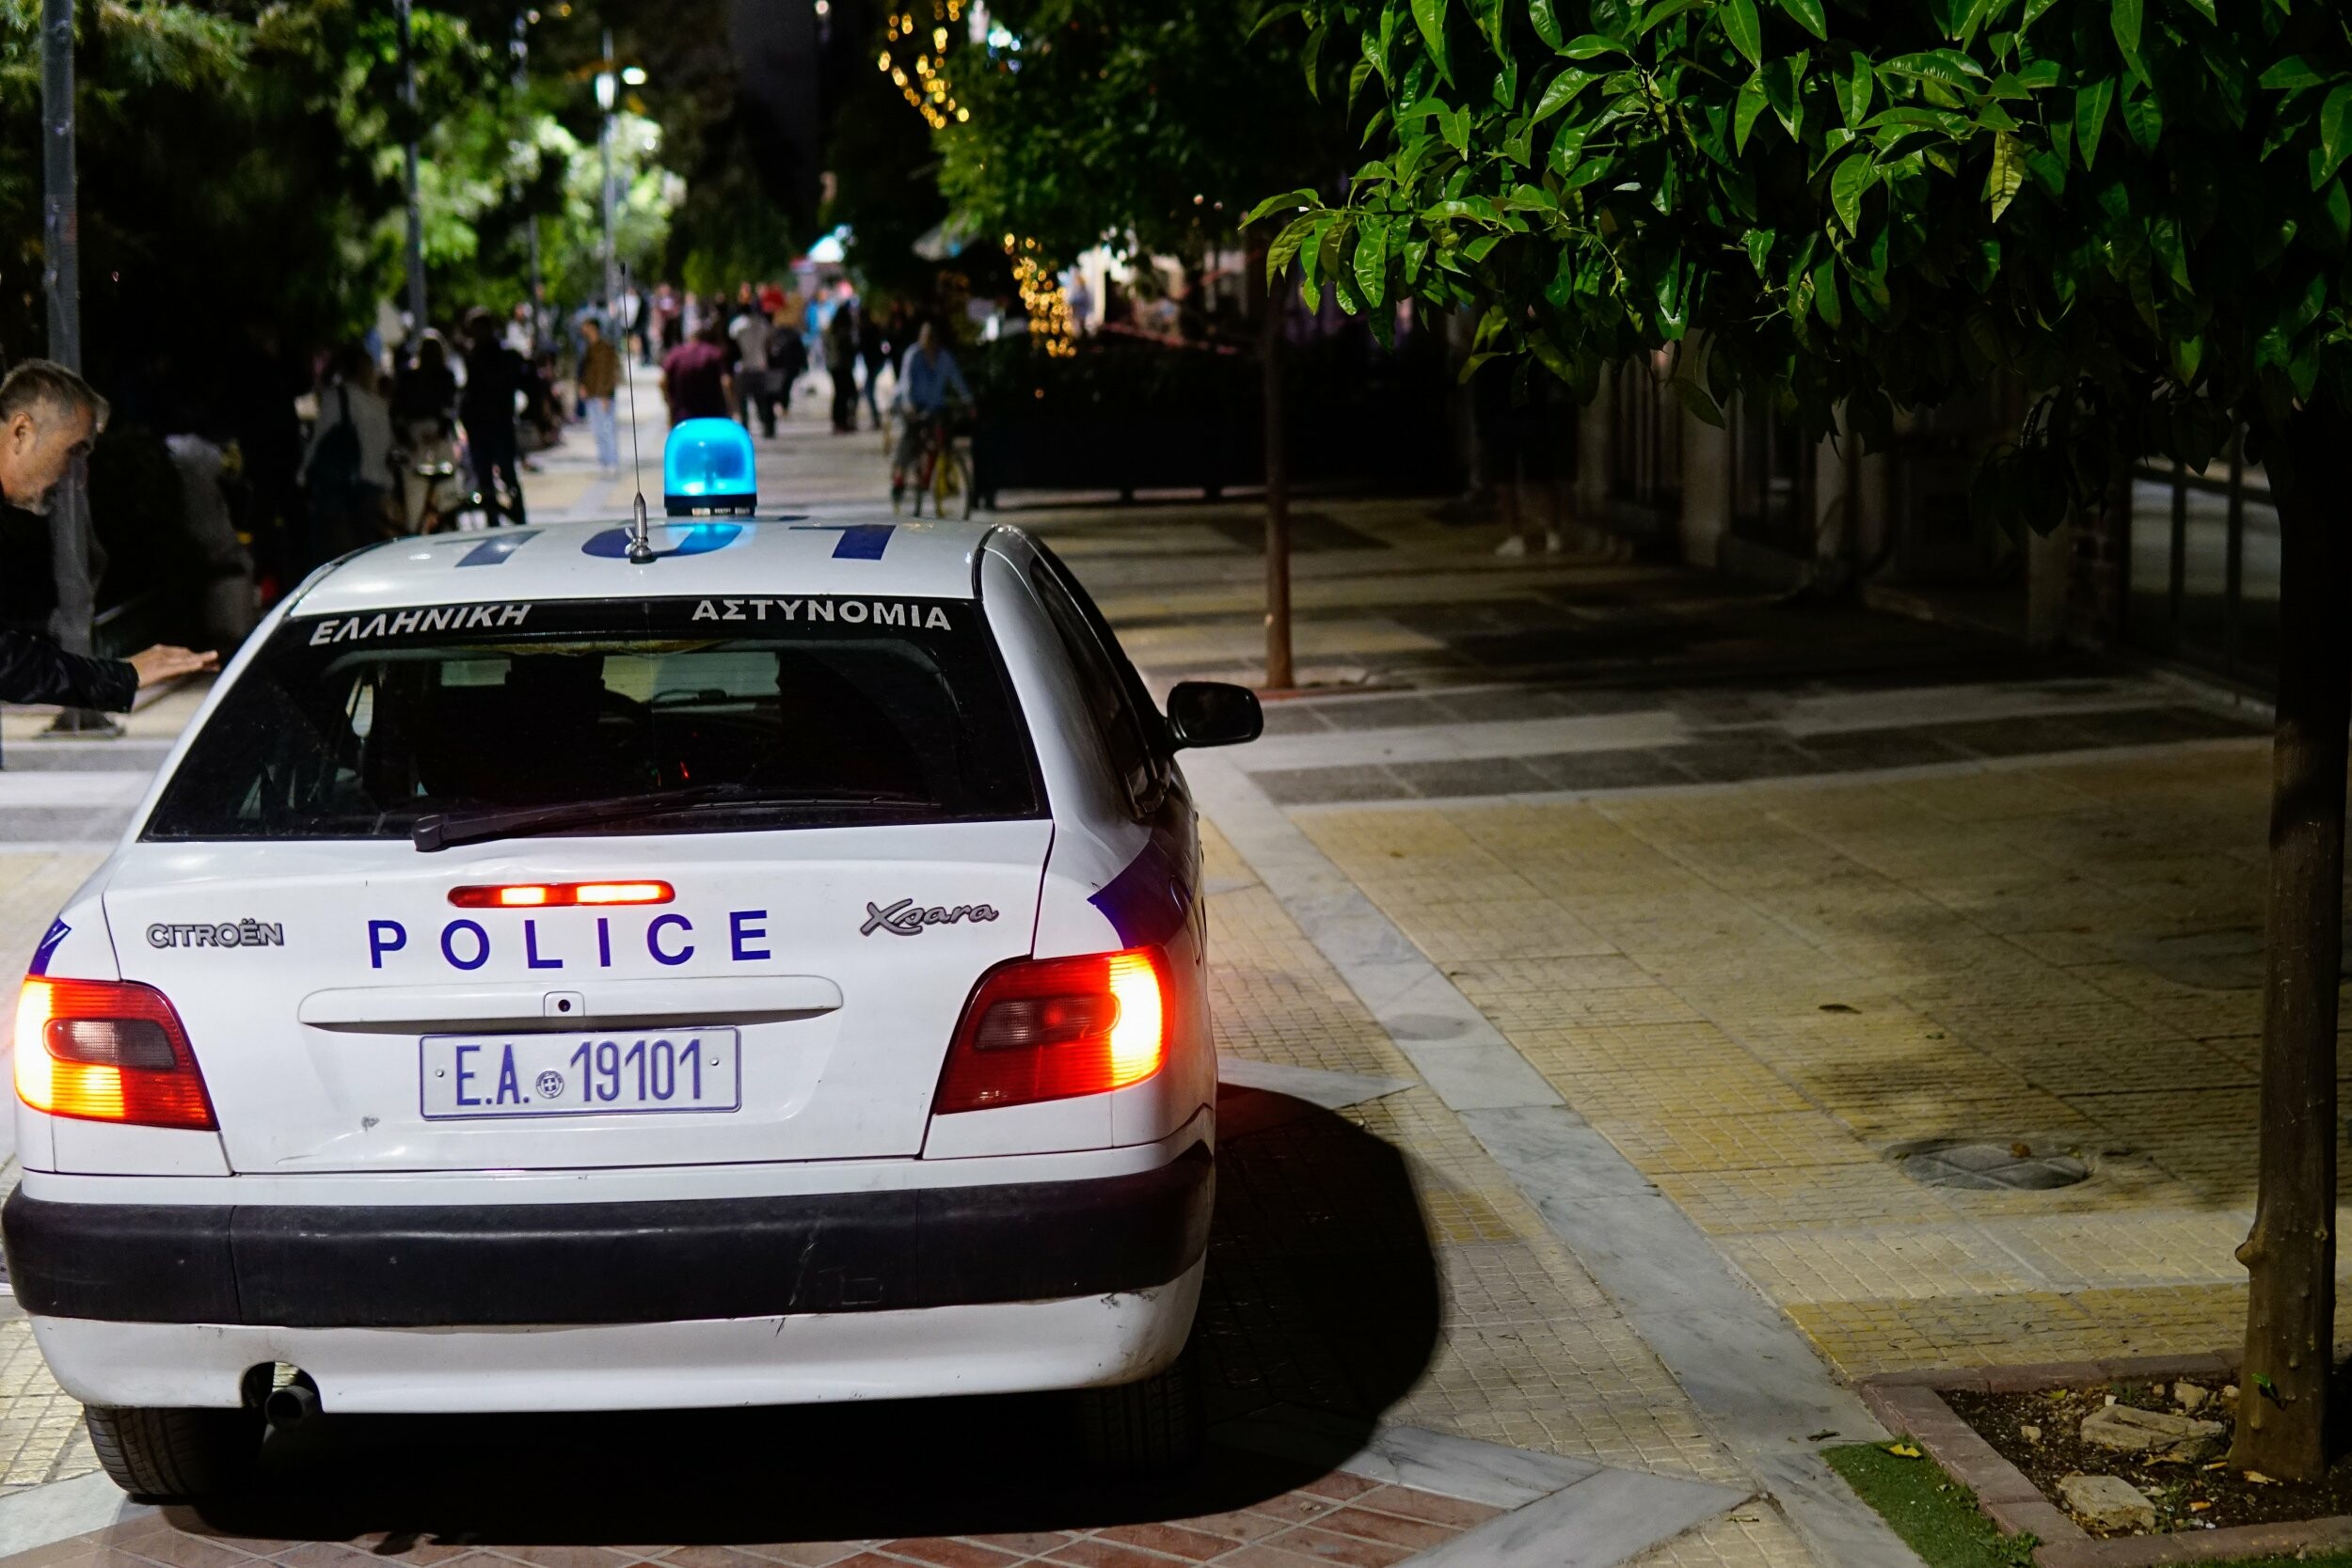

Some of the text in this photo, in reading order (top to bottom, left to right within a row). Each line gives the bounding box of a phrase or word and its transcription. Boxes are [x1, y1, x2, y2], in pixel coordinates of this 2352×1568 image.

[309, 599, 952, 646] ΕΛΛΗΝΙΚΗ ΑΣΤΥΝΟΜΙΑ
[146, 918, 284, 949] CITROËN
[368, 910, 771, 971] POLICE
[860, 898, 999, 937] Xsara
[570, 1038, 701, 1102] 19101
